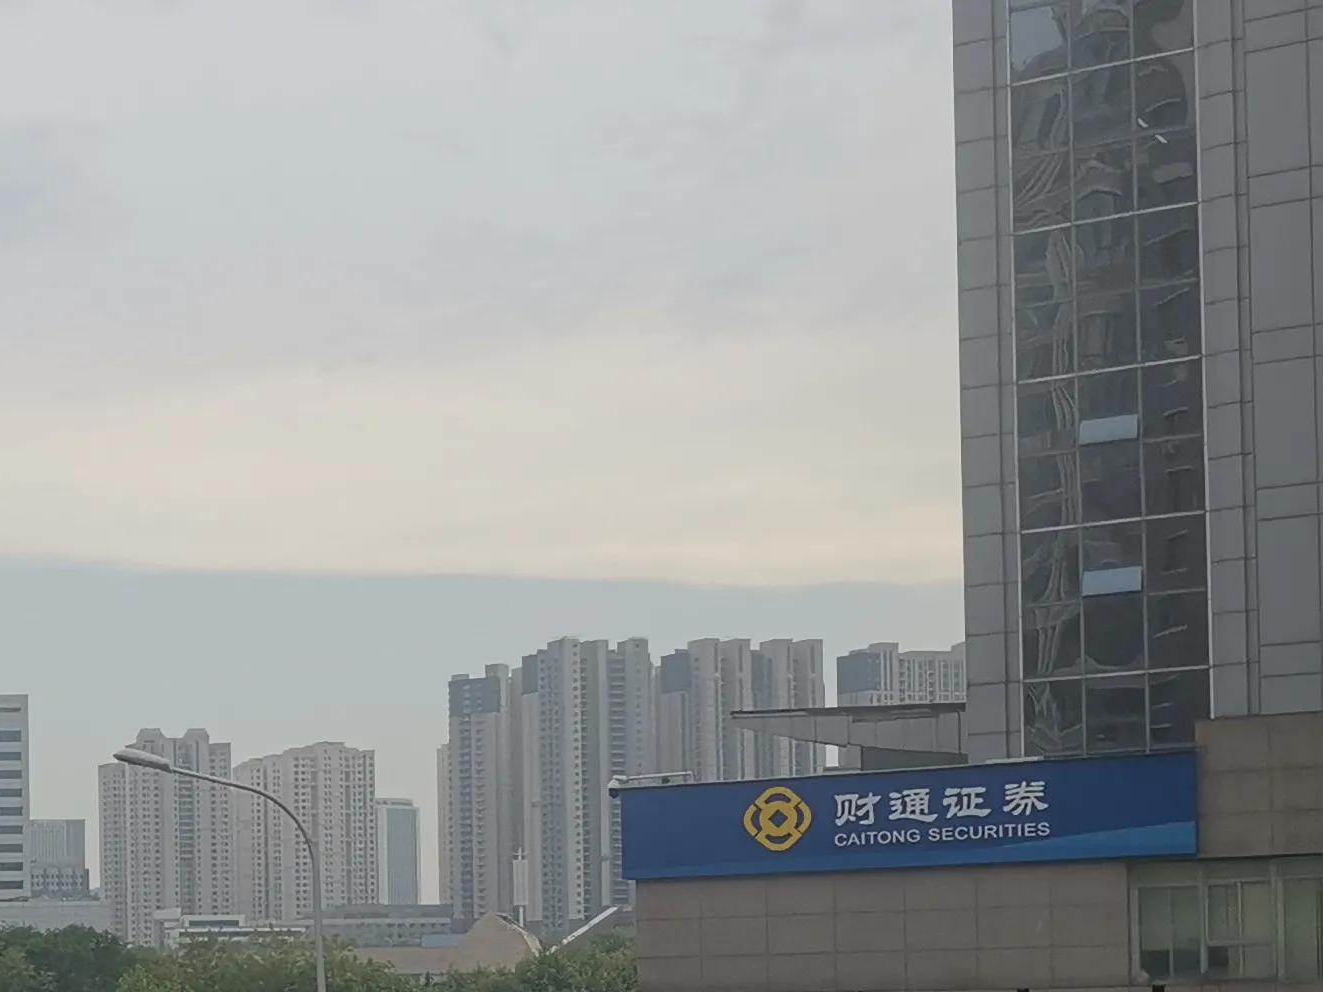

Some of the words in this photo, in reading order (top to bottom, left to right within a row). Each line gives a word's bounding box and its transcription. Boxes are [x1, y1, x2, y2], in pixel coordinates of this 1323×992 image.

[833, 780, 1050, 827] 财通证券
[834, 828, 921, 847] CAITONG
[928, 822, 1051, 842] SECURITIES
